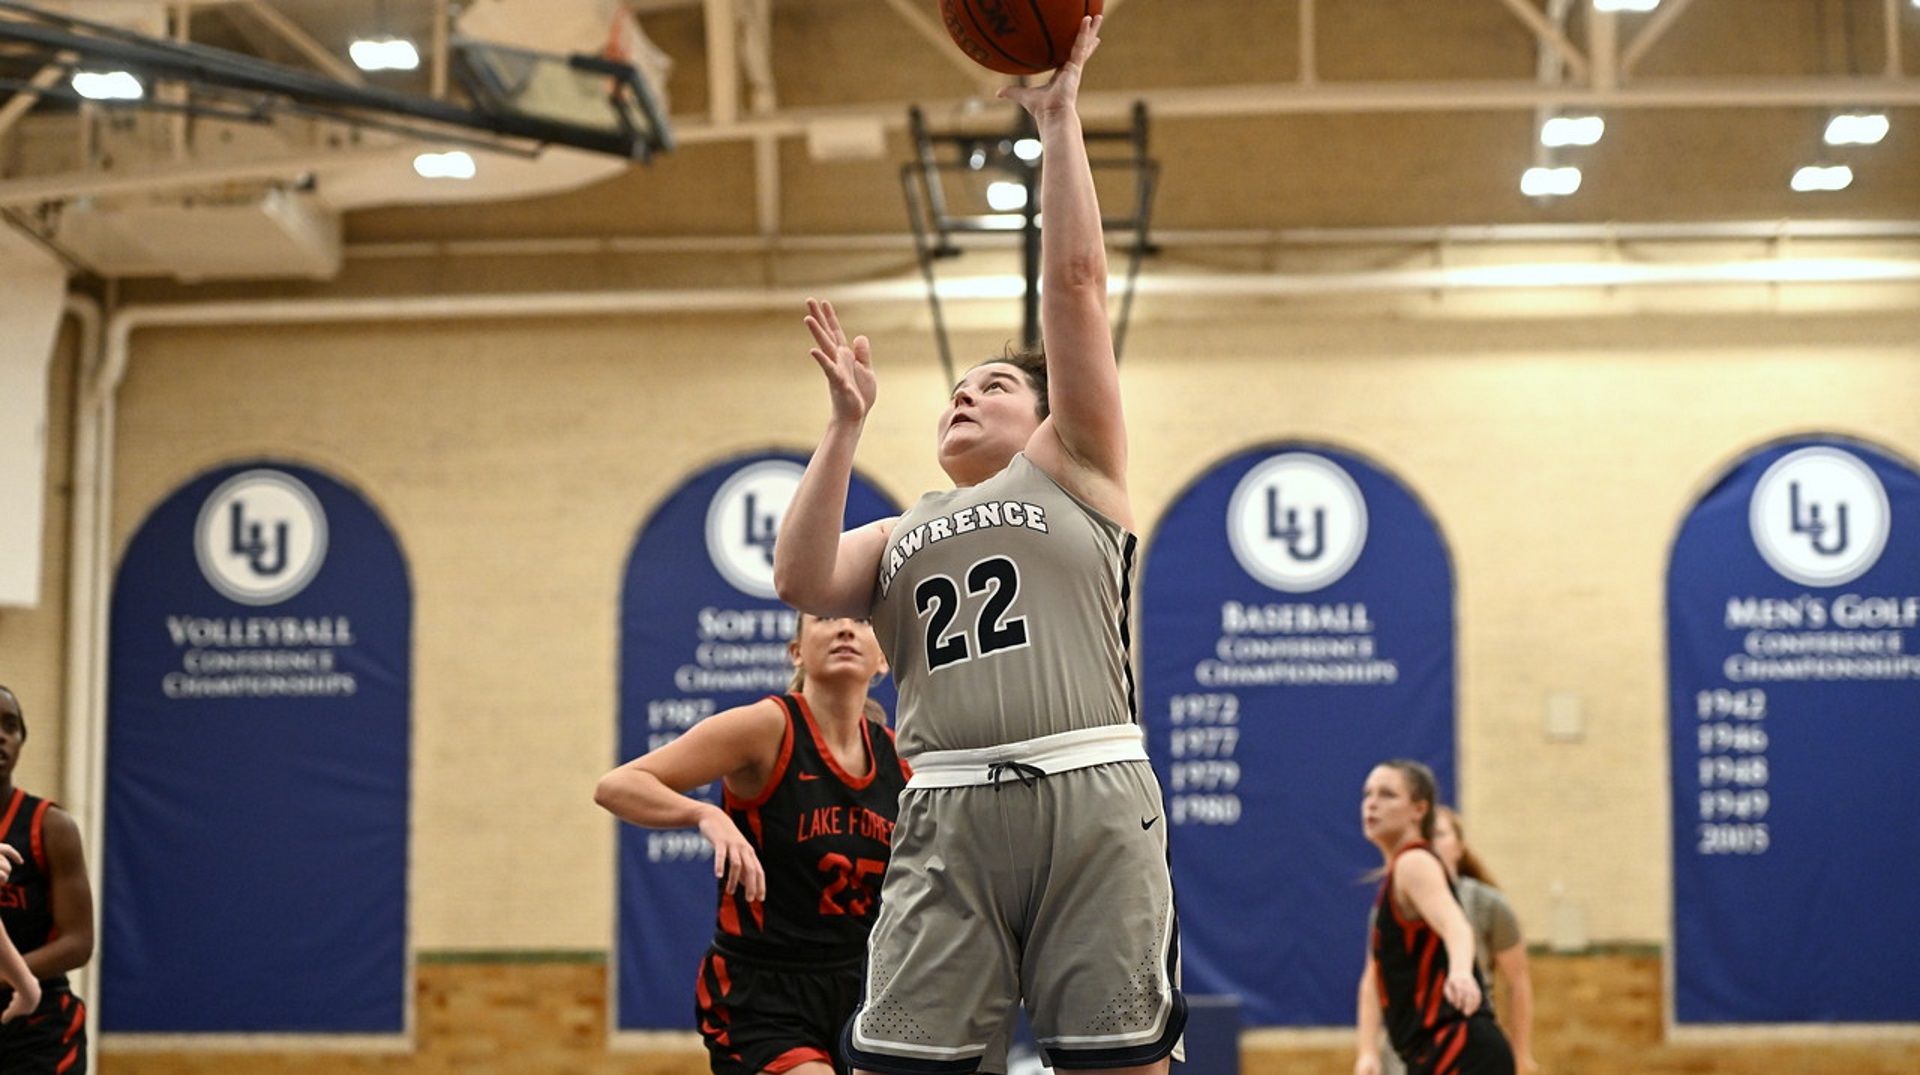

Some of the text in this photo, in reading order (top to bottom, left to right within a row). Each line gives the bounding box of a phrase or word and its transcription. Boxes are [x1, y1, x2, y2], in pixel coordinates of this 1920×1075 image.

[879, 501, 1049, 598] LAWRENCE
[914, 554, 1031, 676] 22
[1223, 603, 1371, 632] BASEBALL
[1726, 596, 1919, 628] MEN'S GOLF
[167, 617, 353, 644] VOLLEYBALL
[1746, 632, 1902, 657] CONFERENCE
[184, 651, 334, 673] CONFERENCE
[1218, 637, 1374, 662] CONFERENCE
[163, 673, 356, 697] CHAMPIONSHIPS
[1197, 661, 1396, 685] CHAMPIONSHIPS
[1171, 694, 1238, 723] 1972
[1699, 690, 1765, 718] 1942
[1172, 728, 1238, 756] 1977
[1699, 724, 1767, 752] 1946
[1172, 762, 1239, 790] 1979
[1700, 758, 1767, 786] 1948
[1173, 795, 1240, 823] 1980
[1701, 791, 1768, 819] 1949
[797, 806, 843, 842] LAKE
[1699, 825, 1768, 853] 2005
[818, 852, 885, 916] 25
